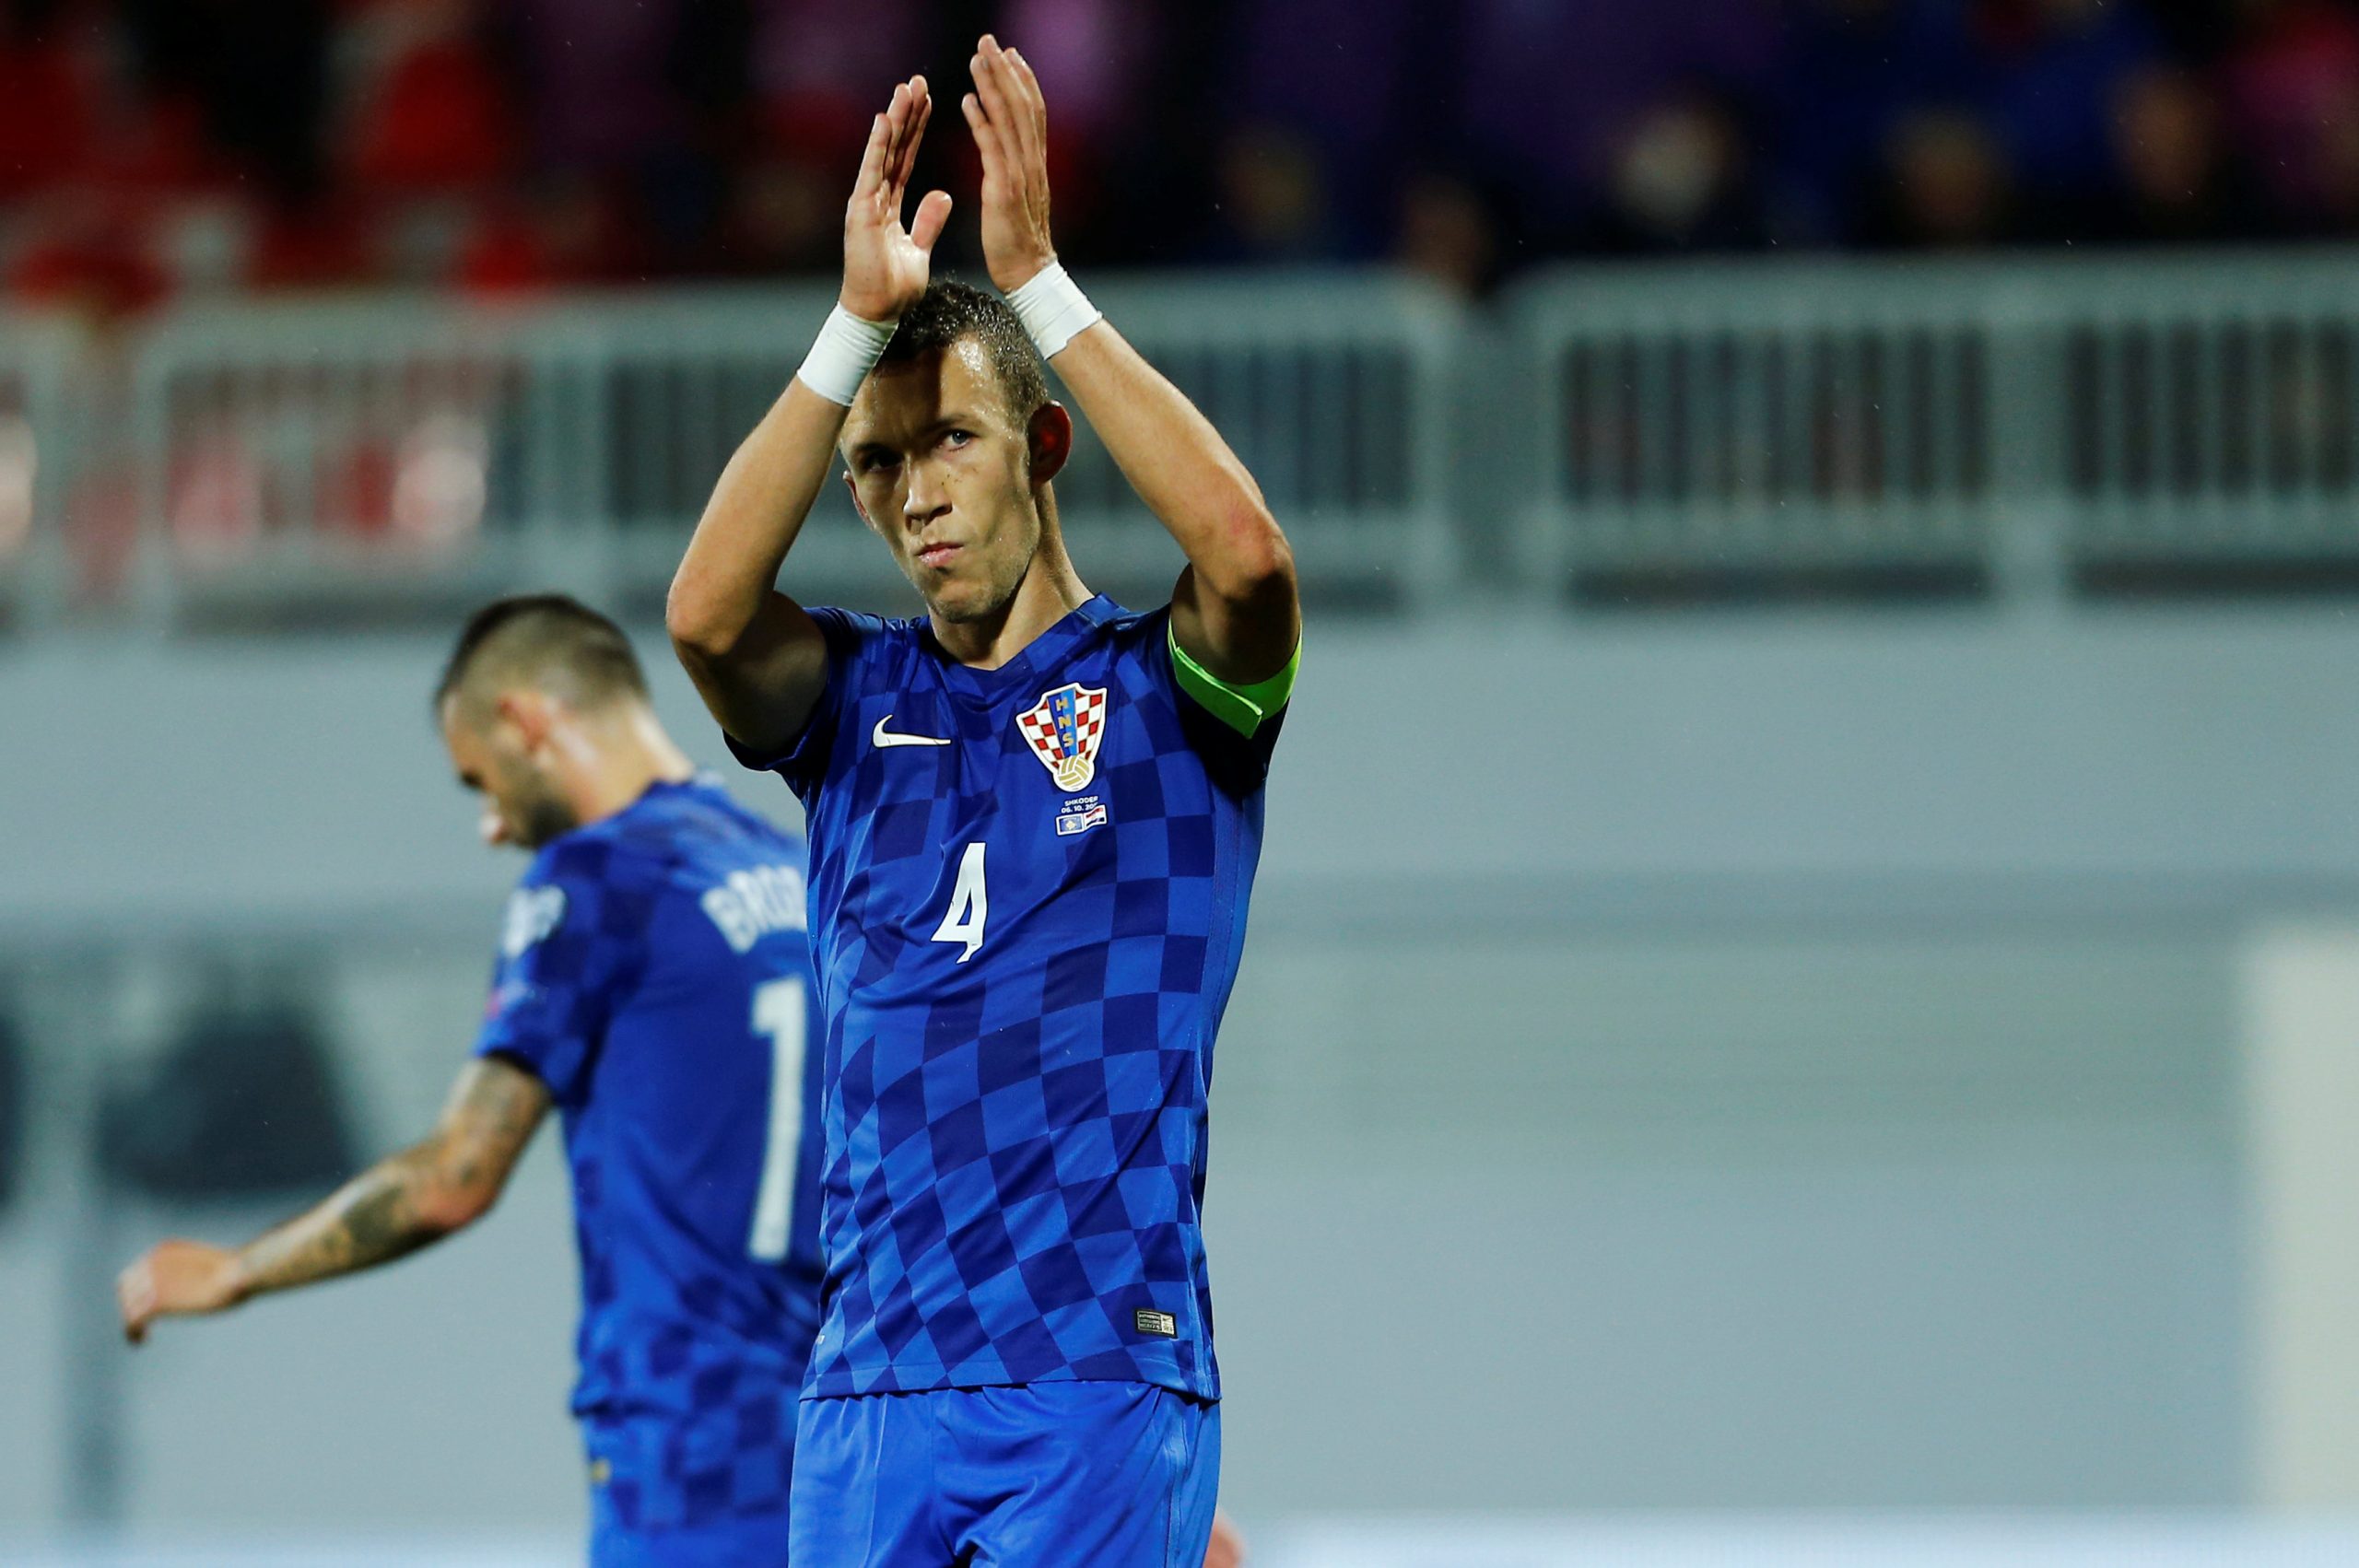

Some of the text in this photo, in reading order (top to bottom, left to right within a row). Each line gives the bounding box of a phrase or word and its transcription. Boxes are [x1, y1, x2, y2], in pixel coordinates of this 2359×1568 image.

[1055, 697, 1074, 747] HNS
[931, 842, 987, 964] 4
[750, 976, 806, 1263] 1
